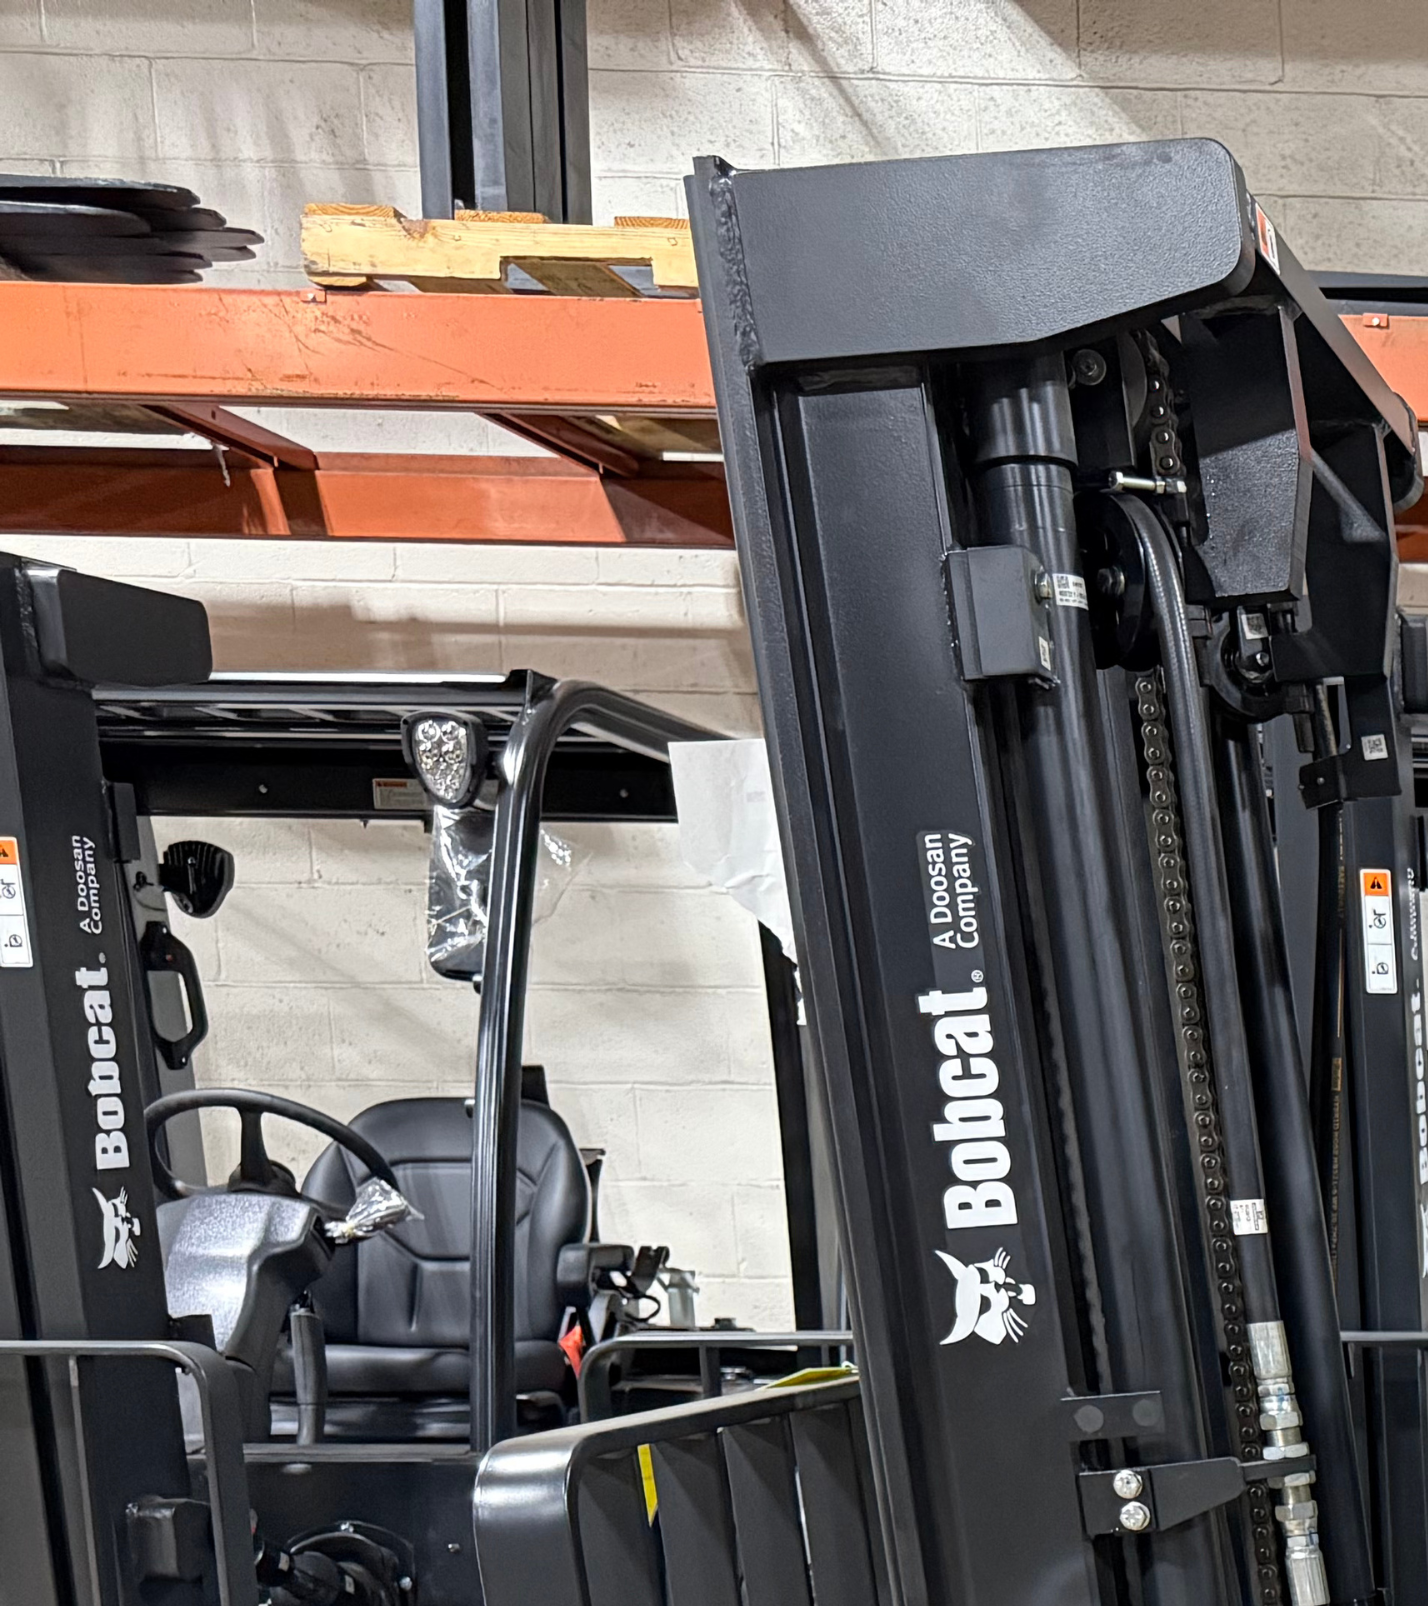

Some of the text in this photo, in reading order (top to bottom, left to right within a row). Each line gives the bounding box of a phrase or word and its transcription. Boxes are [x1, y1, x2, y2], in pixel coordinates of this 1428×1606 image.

[71, 835, 93, 934] A Doosan
[82, 836, 104, 935] Company
[923, 833, 957, 950] A Doosan
[947, 832, 981, 949] Company
[75, 967, 131, 1170] Bobcat
[918, 986, 1018, 1230] Bobcat
